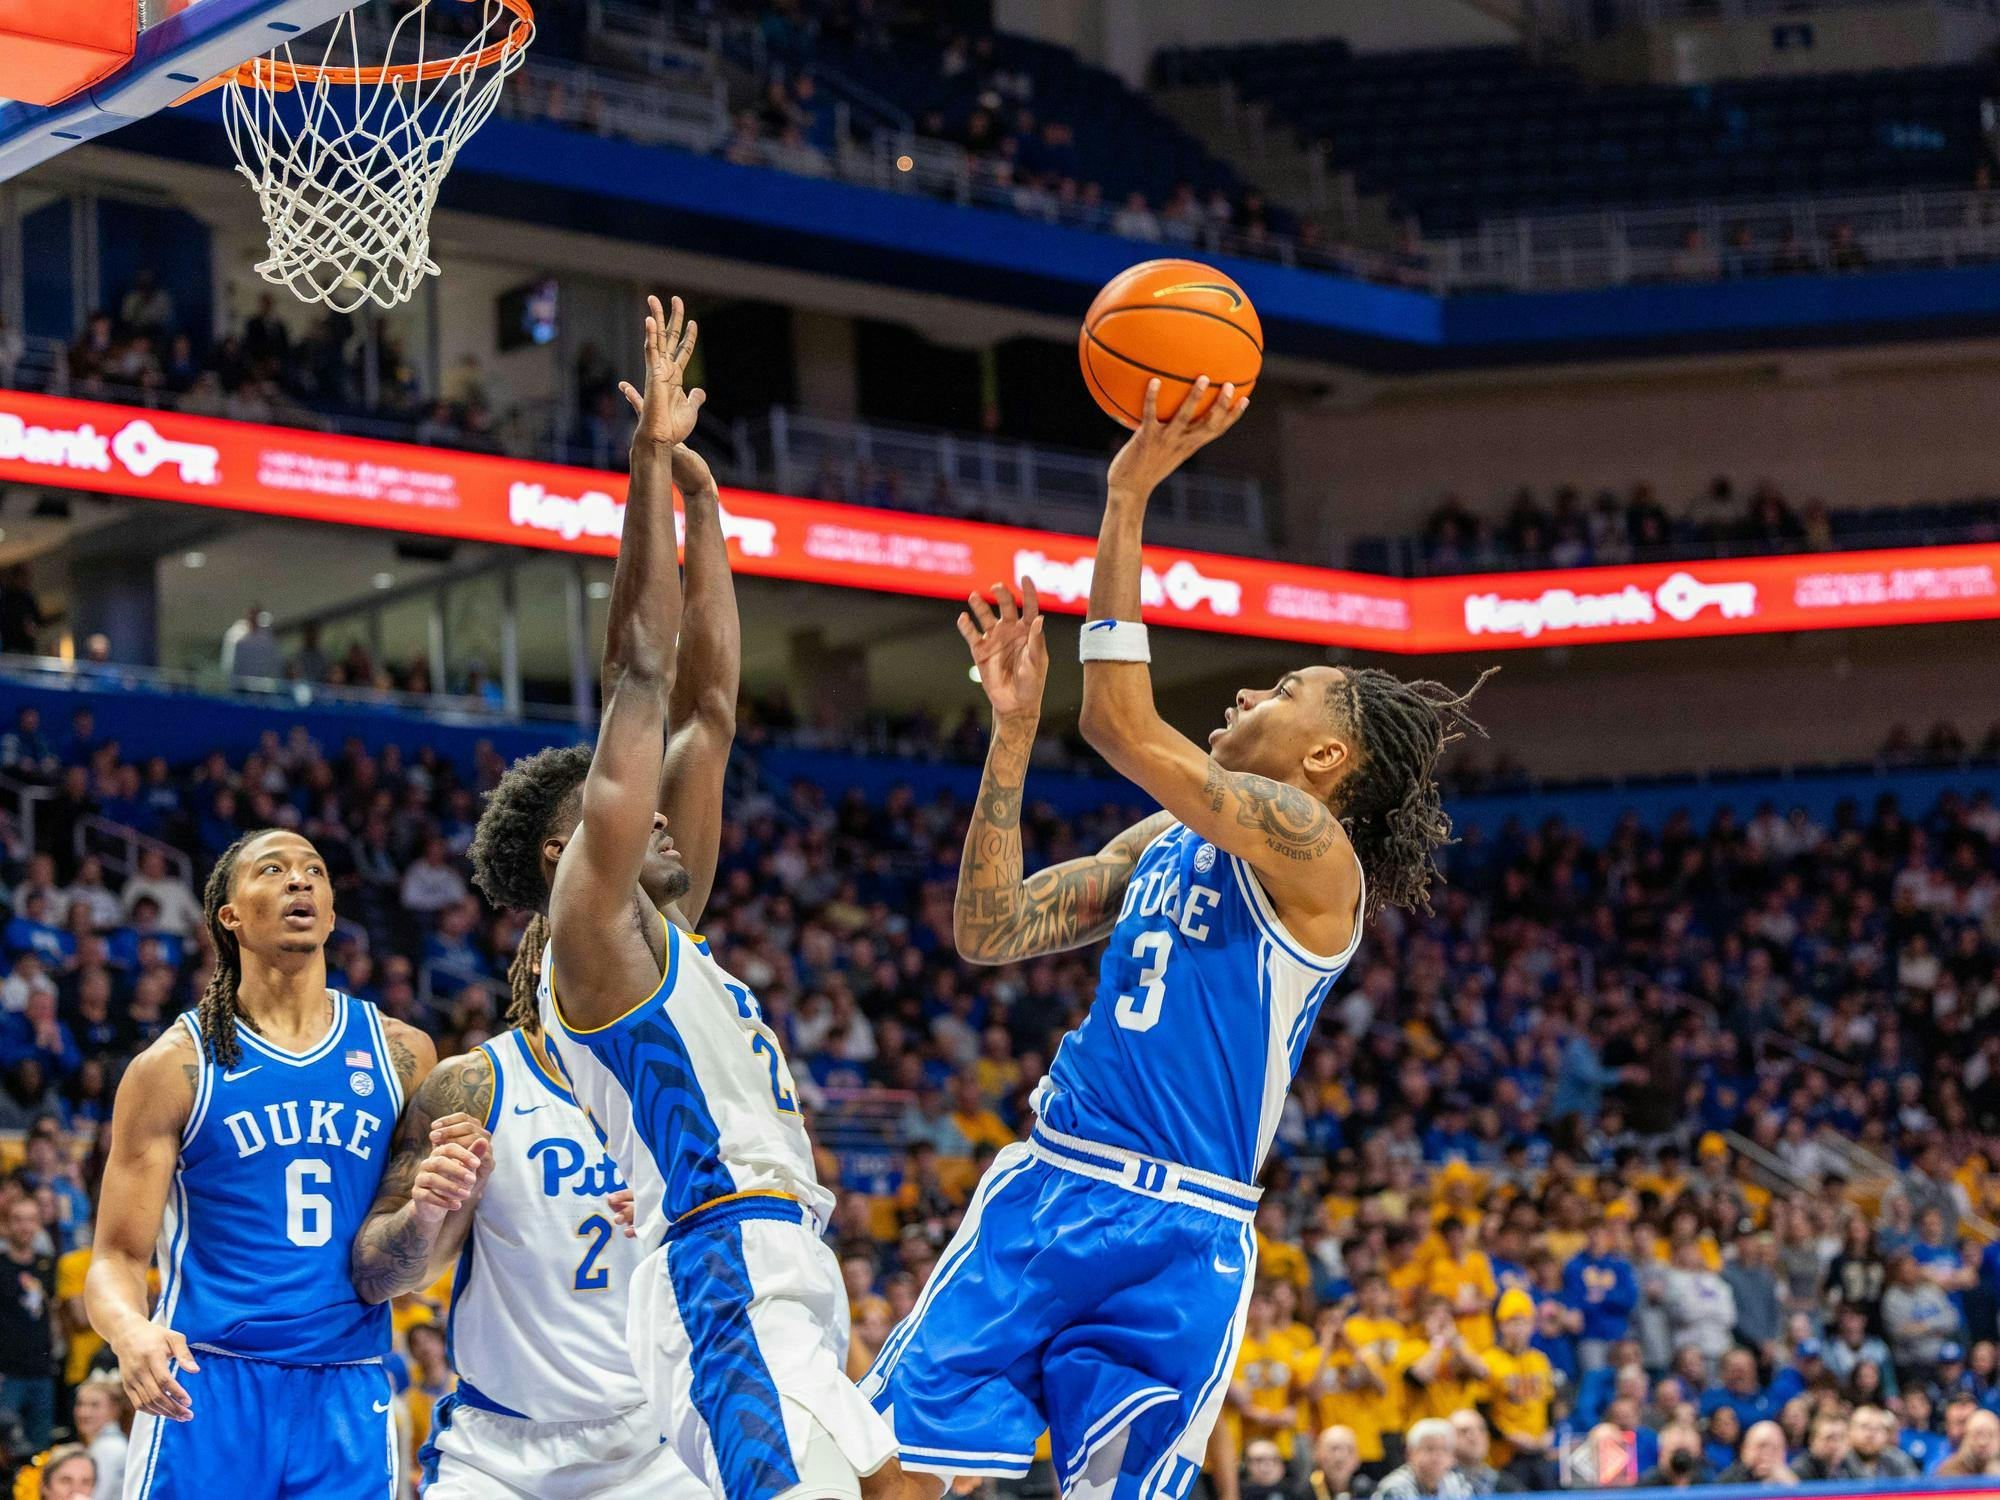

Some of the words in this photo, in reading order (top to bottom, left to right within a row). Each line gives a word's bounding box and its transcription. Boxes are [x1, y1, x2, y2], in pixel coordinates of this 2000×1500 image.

[508, 482, 627, 540] KeyB
[1265, 837, 1312, 861] BURDEN
[1114, 930, 1174, 1032] 3
[223, 1100, 381, 1160] DUKE
[527, 1137, 629, 1197] Pit
[285, 1158, 332, 1247] 6
[574, 1212, 613, 1292] 2
